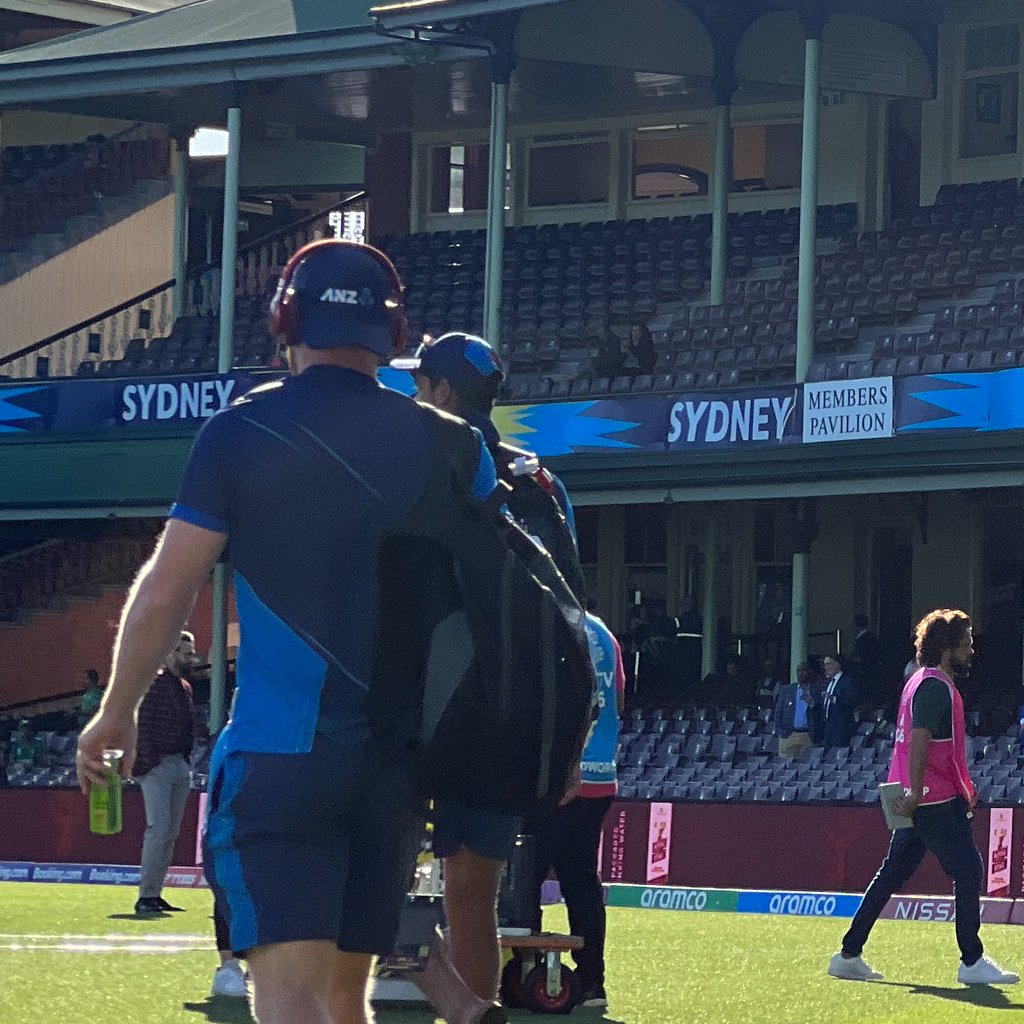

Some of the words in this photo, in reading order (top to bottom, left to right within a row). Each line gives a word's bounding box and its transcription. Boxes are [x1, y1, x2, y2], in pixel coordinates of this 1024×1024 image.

[320, 287, 358, 305] ANZ
[122, 379, 236, 421] SYDNEY
[808, 386, 888, 410] MEMBERS
[667, 397, 793, 443] SYDNEY
[809, 412, 886, 436] PAVILION
[640, 888, 708, 911] aramco
[769, 894, 837, 916] aramco
